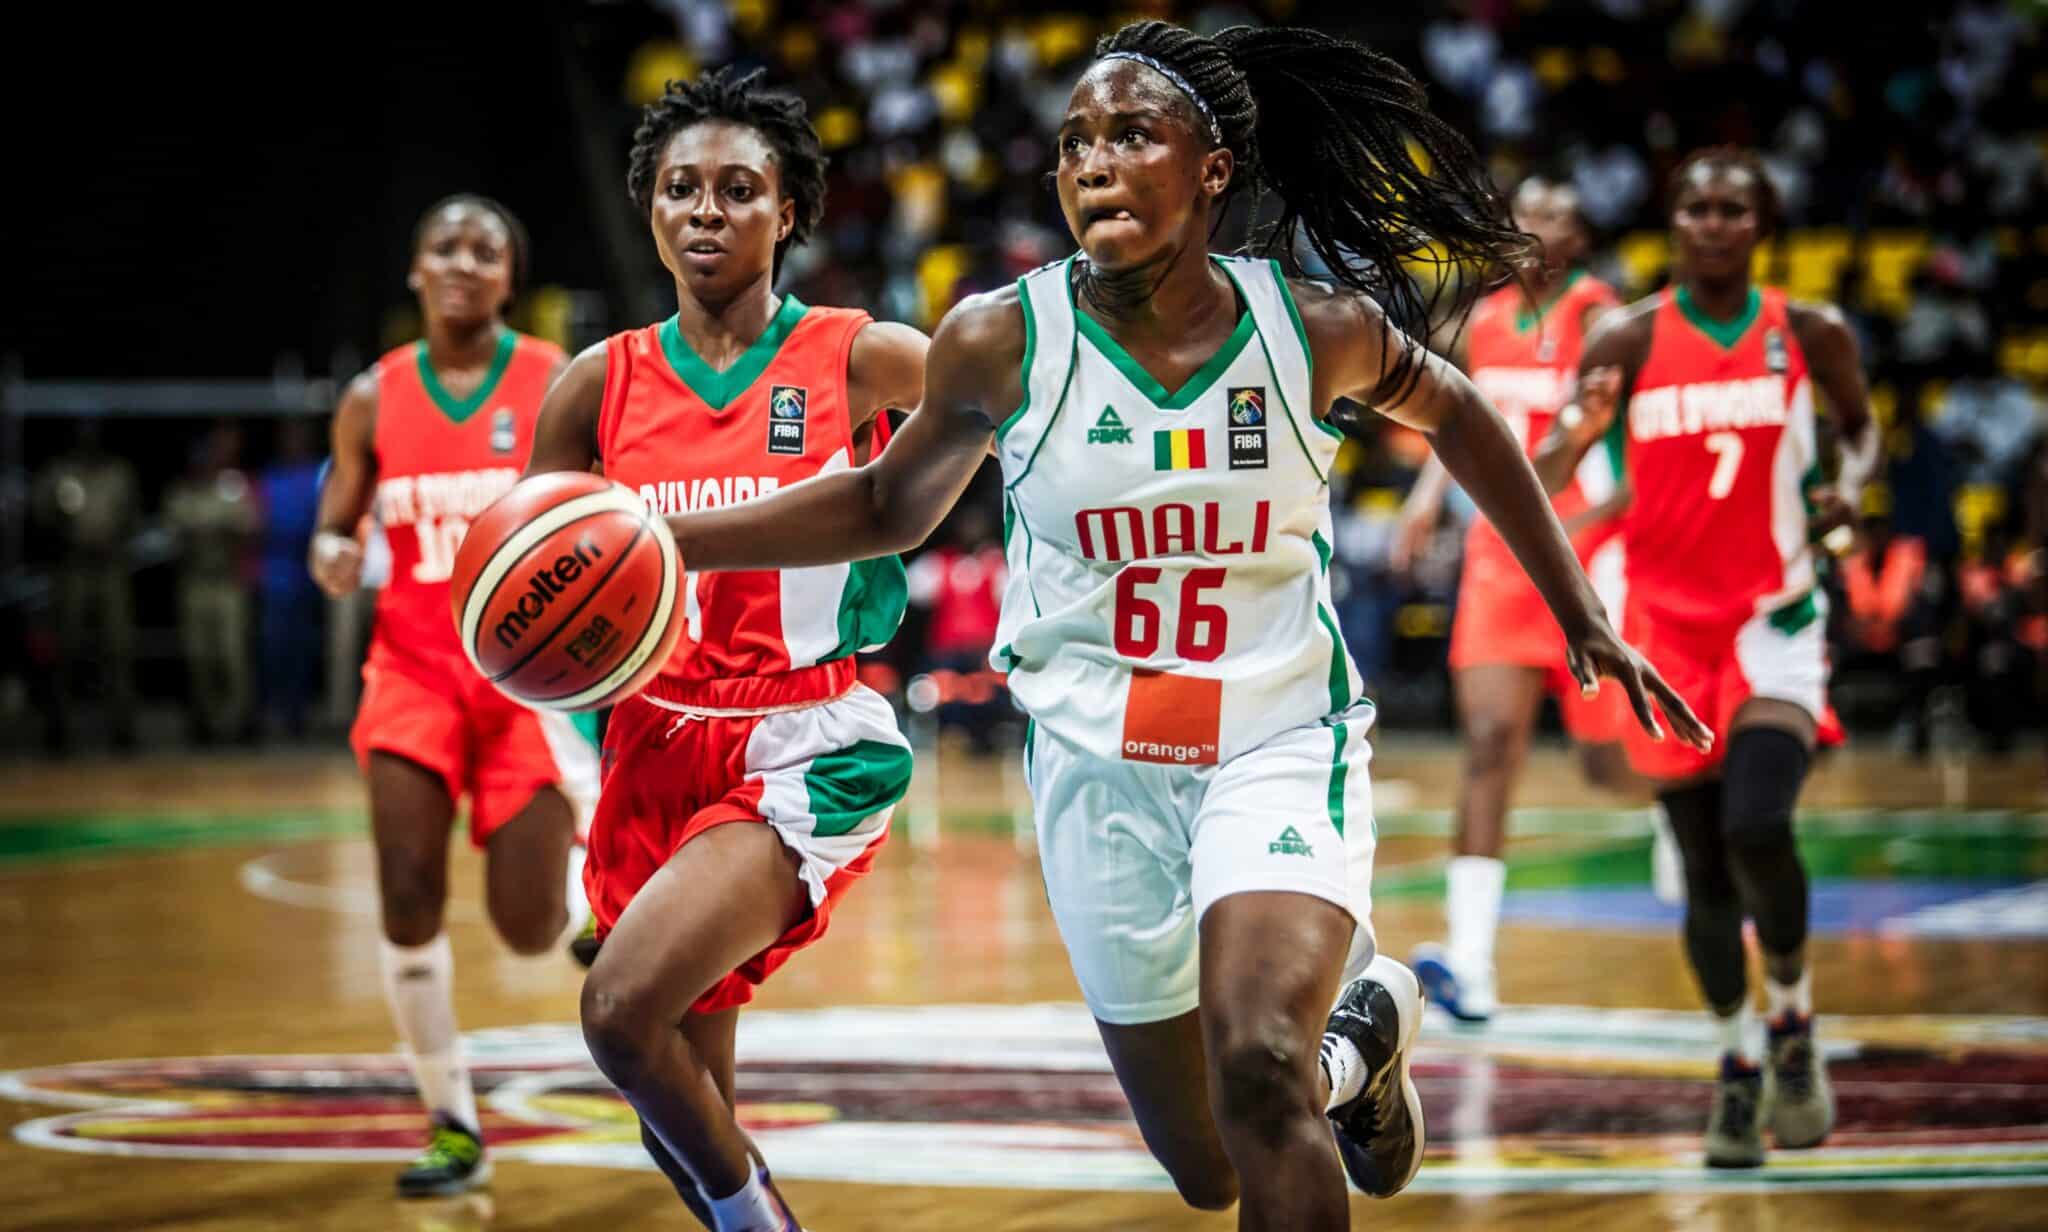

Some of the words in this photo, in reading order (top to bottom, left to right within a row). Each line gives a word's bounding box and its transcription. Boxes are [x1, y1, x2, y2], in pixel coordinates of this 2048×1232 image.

[774, 424, 800, 439] FIBA
[1087, 427, 1134, 445] PEAK
[1234, 433, 1262, 449] FIBA
[1704, 432, 1744, 499] 7
[1075, 500, 1270, 562] MALI
[495, 539, 603, 648] molten
[1114, 566, 1228, 663] 66
[565, 614, 614, 662] FIBA
[1269, 842, 1315, 858] PEAK
